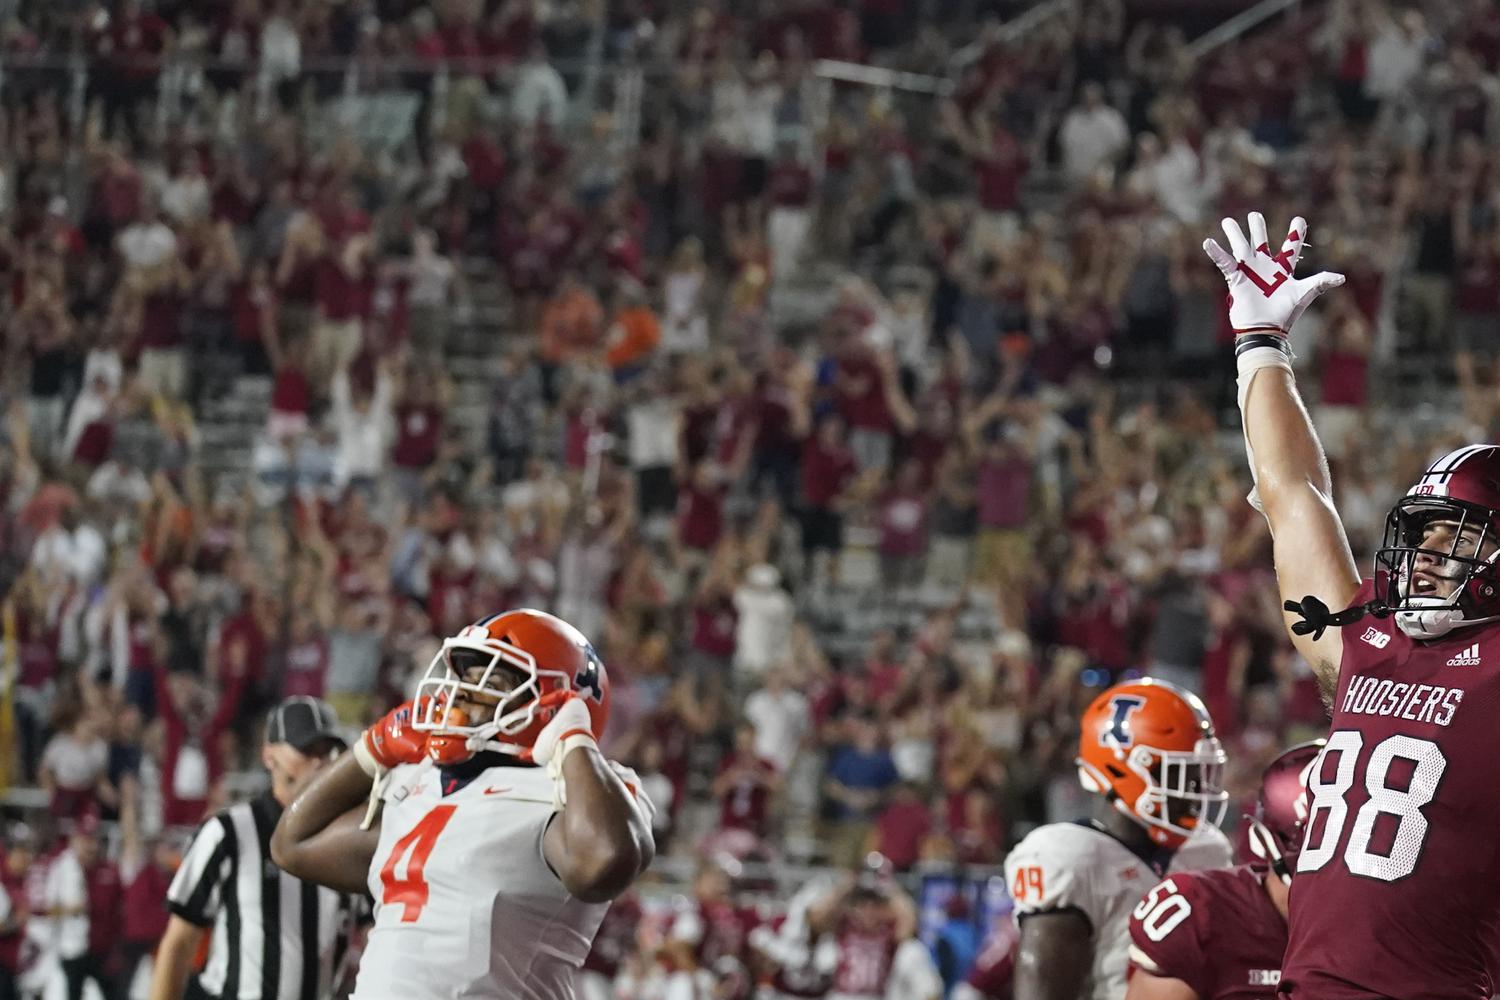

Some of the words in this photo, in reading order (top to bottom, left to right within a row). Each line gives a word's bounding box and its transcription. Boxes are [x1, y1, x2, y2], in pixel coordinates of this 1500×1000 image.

[1446, 657, 1481, 667] adidas
[1340, 674, 1465, 727] HOOSIERS
[1296, 730, 1447, 883] 88
[380, 804, 458, 923] 4
[1013, 865, 1045, 902] 49
[1133, 878, 1192, 943] 50
